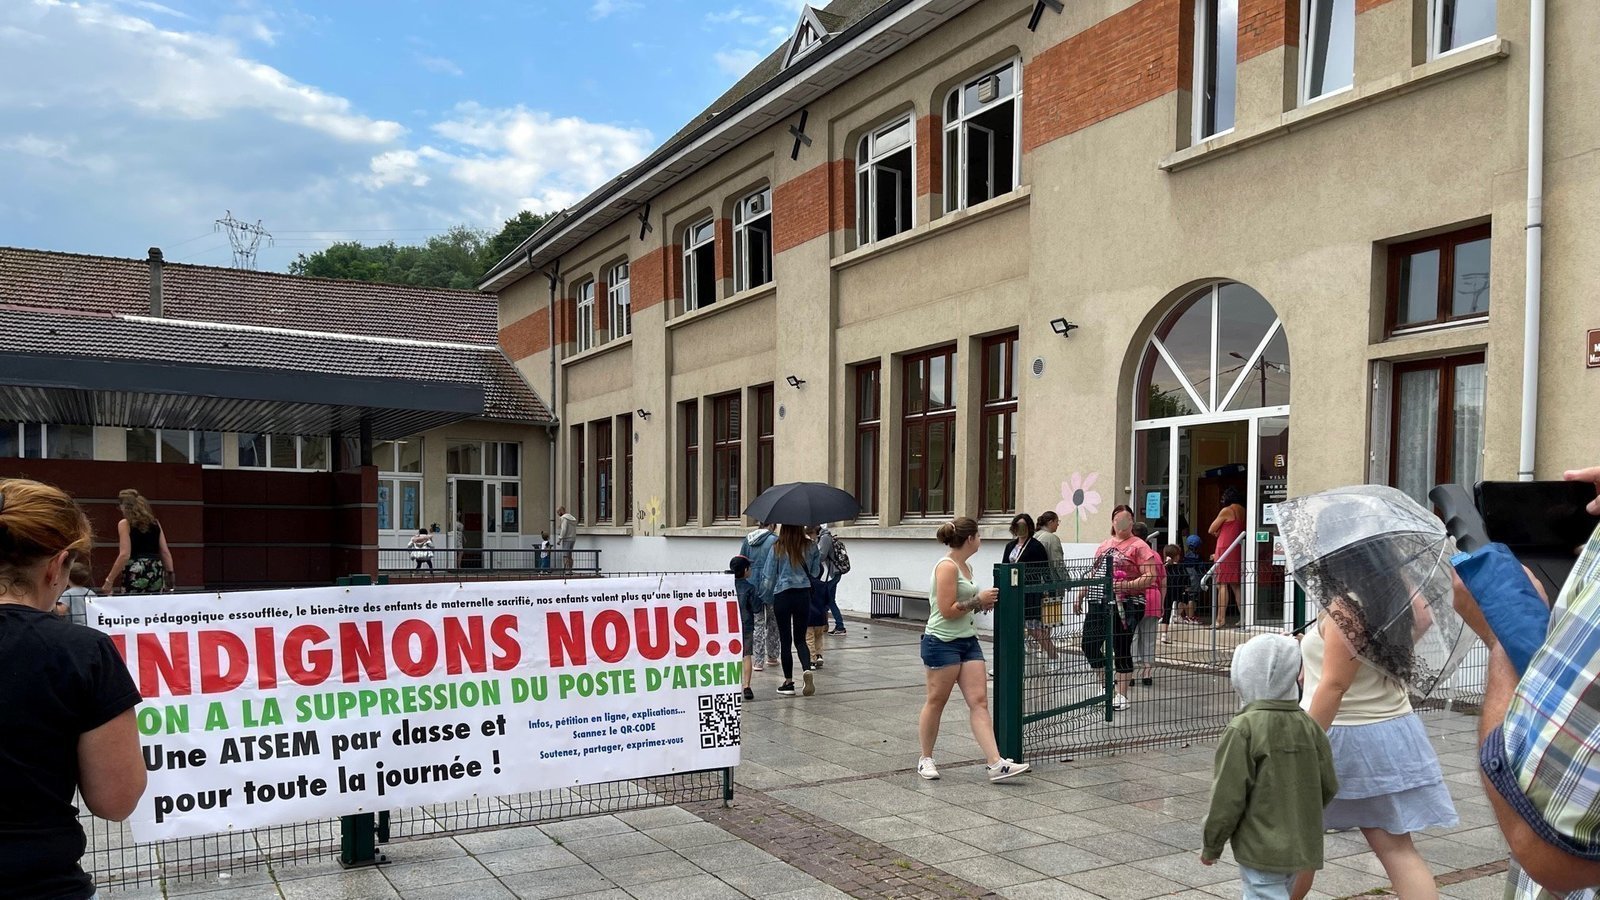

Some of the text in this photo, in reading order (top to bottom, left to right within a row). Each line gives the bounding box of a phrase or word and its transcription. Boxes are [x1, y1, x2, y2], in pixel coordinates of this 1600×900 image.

[98, 613, 140, 627] Équipe
[145, 611, 224, 626] pédagogique
[228, 607, 293, 619] essoufflée,
[296, 605, 307, 616] le
[310, 604, 360, 615] bien-être
[363, 602, 381, 613] des
[384, 601, 422, 612] enfants
[425, 600, 438, 610] de
[441, 598, 494, 609] maternelle
[497, 596, 534, 607] sacrifié,
[536, 597, 553, 605] nos
[555, 594, 589, 604] enfants
[591, 593, 618, 602] valent
[621, 592, 639, 603] plus
[641, 591, 671, 602] qu'une
[673, 590, 693, 601] ligne
[695, 589, 706, 598] de
[109, 601, 742, 698] NDIGNONS NOUS!!
[137, 704, 190, 736] ON
[204, 701, 229, 731] A
[242, 697, 284, 728] LA
[295, 679, 501, 723] SUPPRESSION
[511, 675, 548, 704] DU
[559, 669, 636, 699] POSTE
[528, 707, 686, 729] Infos, pétition en ligne, explications...
[142, 714, 506, 771] Une ATSEM par classe et
[539, 736, 684, 759] Soutenez, partager, exprimez-vous
[572, 722, 656, 739] Scannez le QR-CODE
[154, 749, 502, 823] pour toute la journée !
